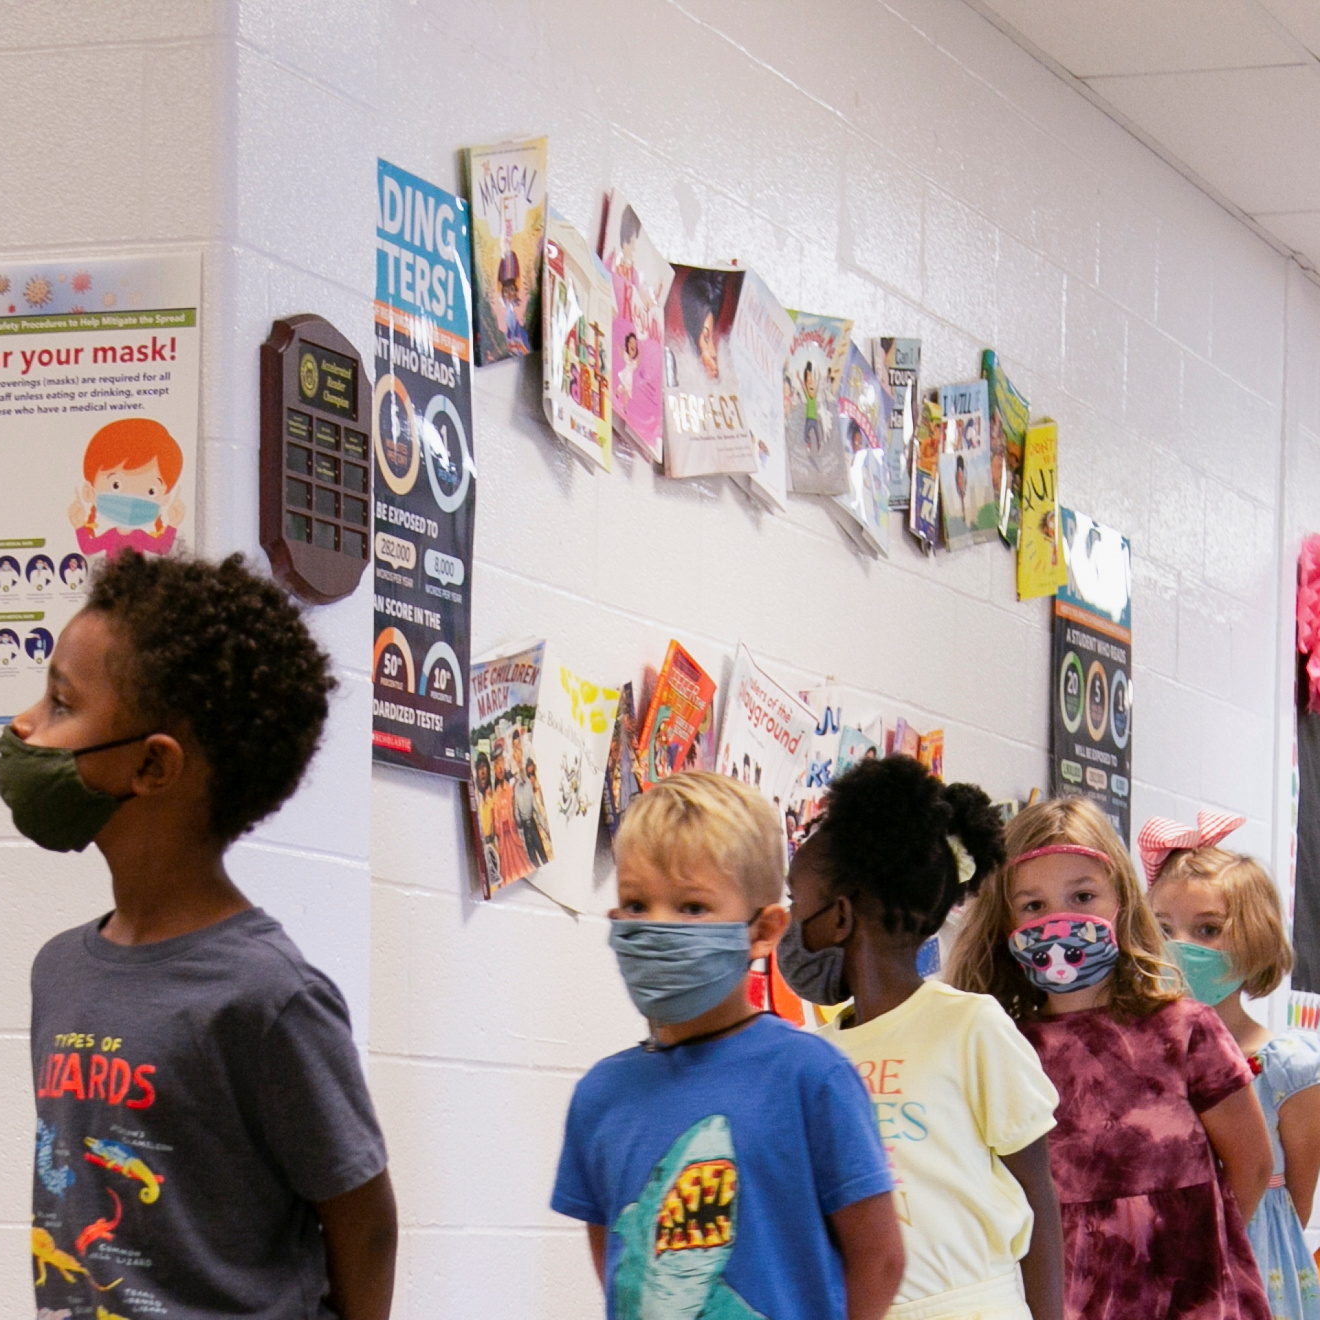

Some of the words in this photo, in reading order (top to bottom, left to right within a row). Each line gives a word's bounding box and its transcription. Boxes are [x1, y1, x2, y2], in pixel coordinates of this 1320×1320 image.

[478, 164, 537, 216] MAGICAL
[21, 318, 67, 330] Procedures
[69, 318, 78, 327] to
[80, 317, 100, 328] Help
[102, 315, 137, 327] Mitigate
[139, 315, 153, 324] the
[155, 314, 185, 325] Spread
[20, 346, 84, 375] your
[92, 336, 176, 364] mask!
[394, 343, 418, 373] WHO
[420, 354, 455, 388] READS
[43, 376, 79, 387] (masks)
[99, 373, 140, 385] required
[142, 372, 156, 382] for
[159, 371, 171, 381] all
[14, 392, 43, 401] unless
[46, 390, 75, 401] eating
[90, 388, 133, 399] drinking,
[136, 387, 169, 397] except
[14, 405, 35, 415] who
[37, 405, 59, 414] have
[70, 402, 107, 412] medical
[109, 401, 145, 411] waiver.
[376, 501, 387, 520] BE
[388, 505, 426, 534] EXPOSED
[426, 519, 438, 539] TO
[381, 538, 410, 562] 282,000
[434, 557, 454, 577] 8,000
[385, 598, 413, 622] SCORE
[414, 606, 423, 625] IN
[424, 610, 441, 630] THE
[472, 670, 489, 696] THE
[489, 664, 540, 686] CHILDREN
[1067, 670, 1078, 695] 20
[1094, 680, 1101, 702] 5
[477, 686, 509, 721] MARCH
[768, 698, 777, 710] of
[777, 704, 791, 723] the
[416, 710, 443, 732] TESTS!
[54, 1032, 95, 1048] TYPES
[101, 1036, 123, 1052] OF
